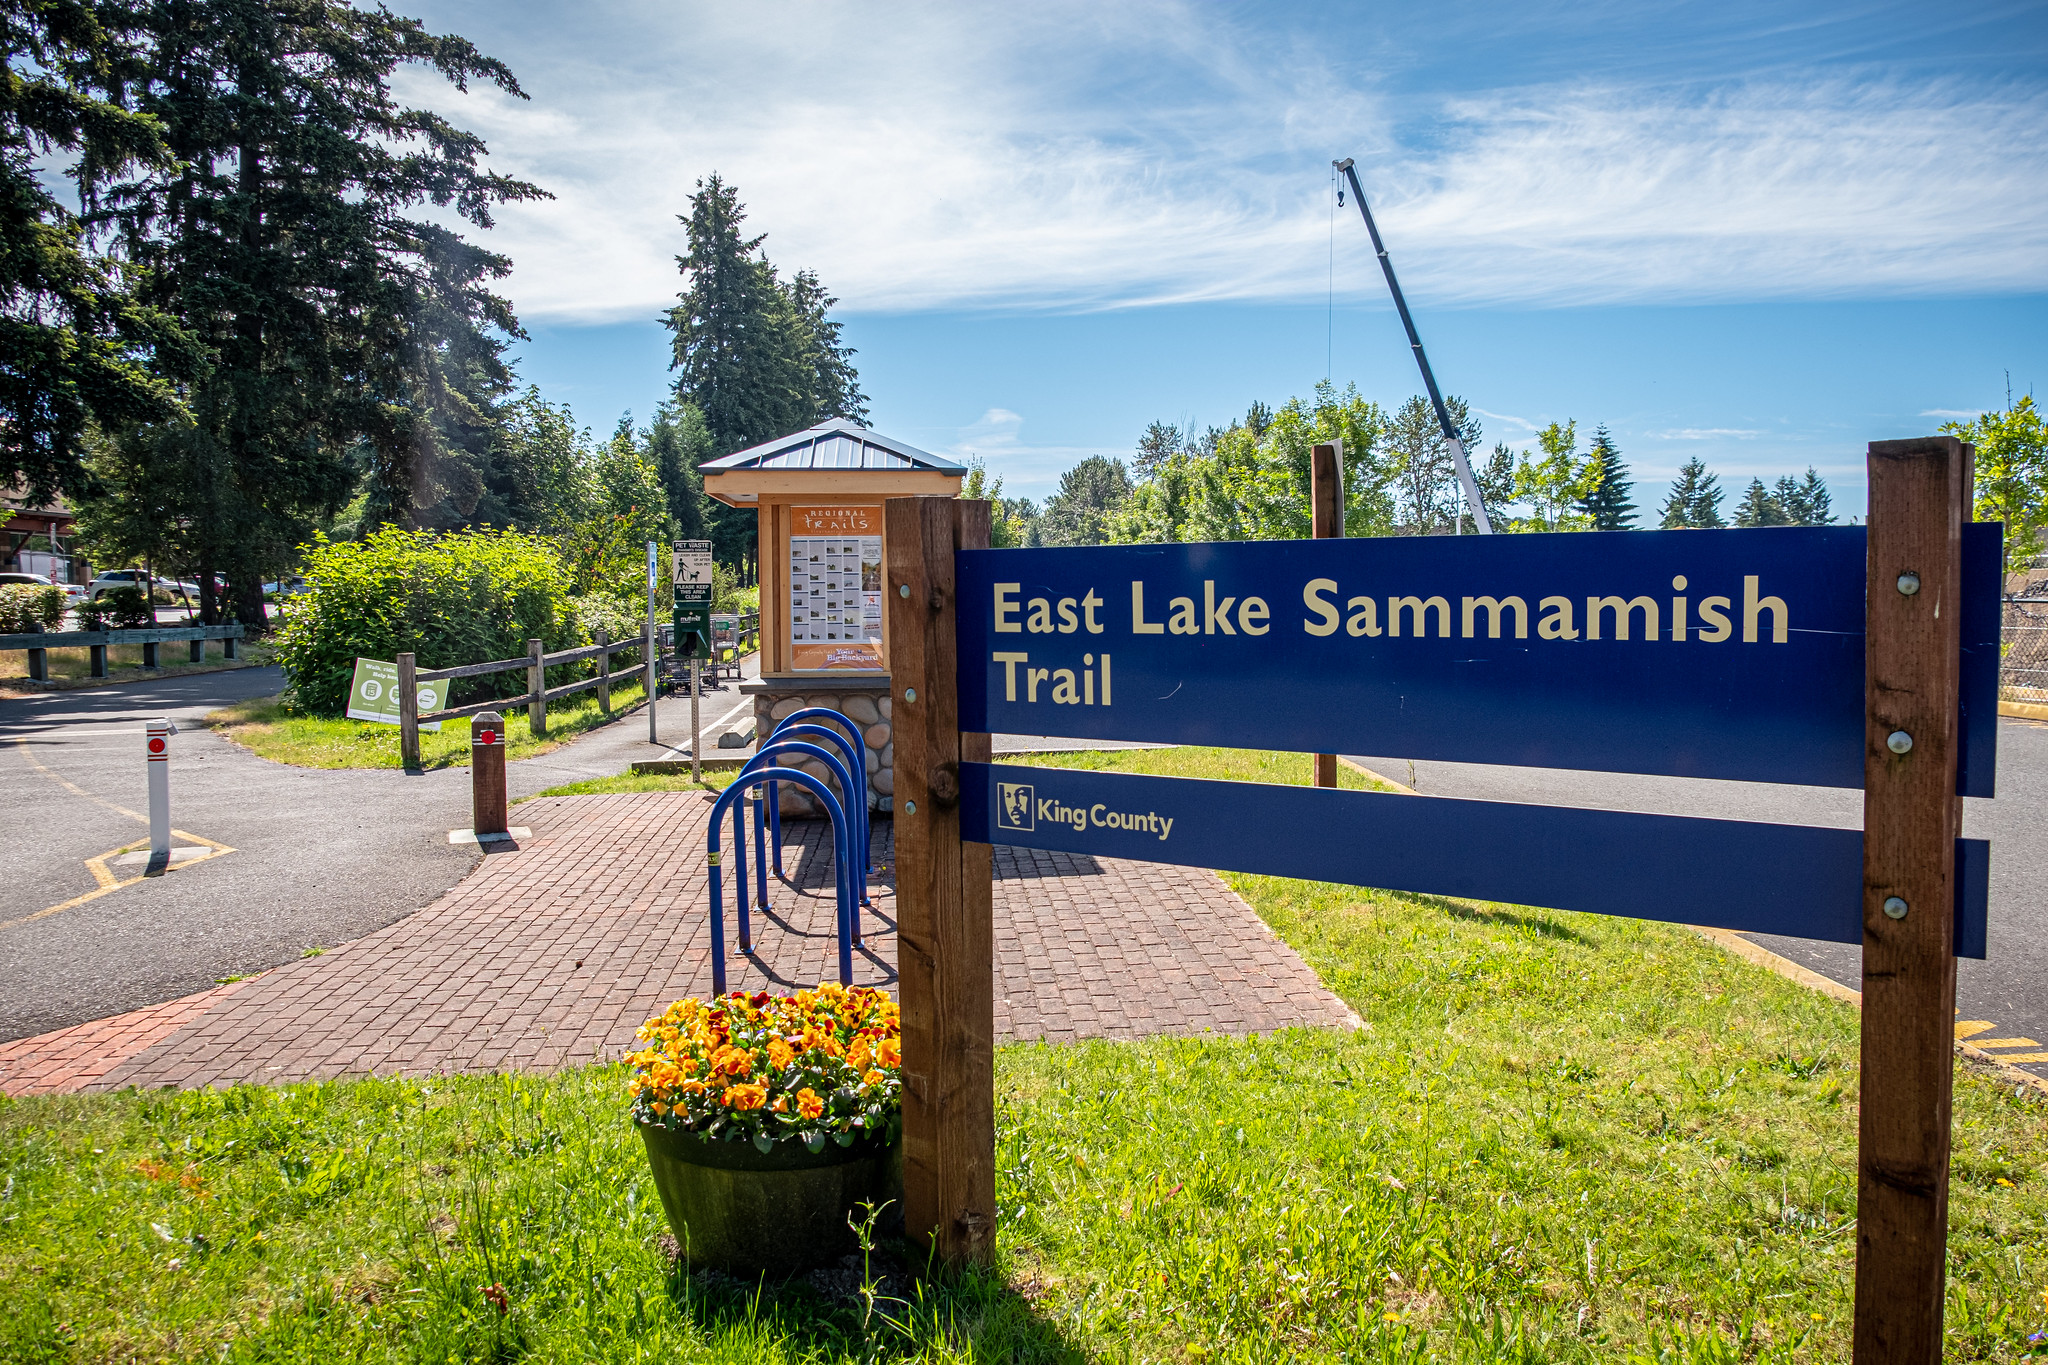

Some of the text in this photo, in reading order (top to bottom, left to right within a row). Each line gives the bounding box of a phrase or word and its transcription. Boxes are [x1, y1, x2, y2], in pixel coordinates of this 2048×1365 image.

[993, 574, 1789, 644] East Lake Sammamish
[992, 651, 1111, 706] Trail
[1038, 798, 1173, 841] King County
